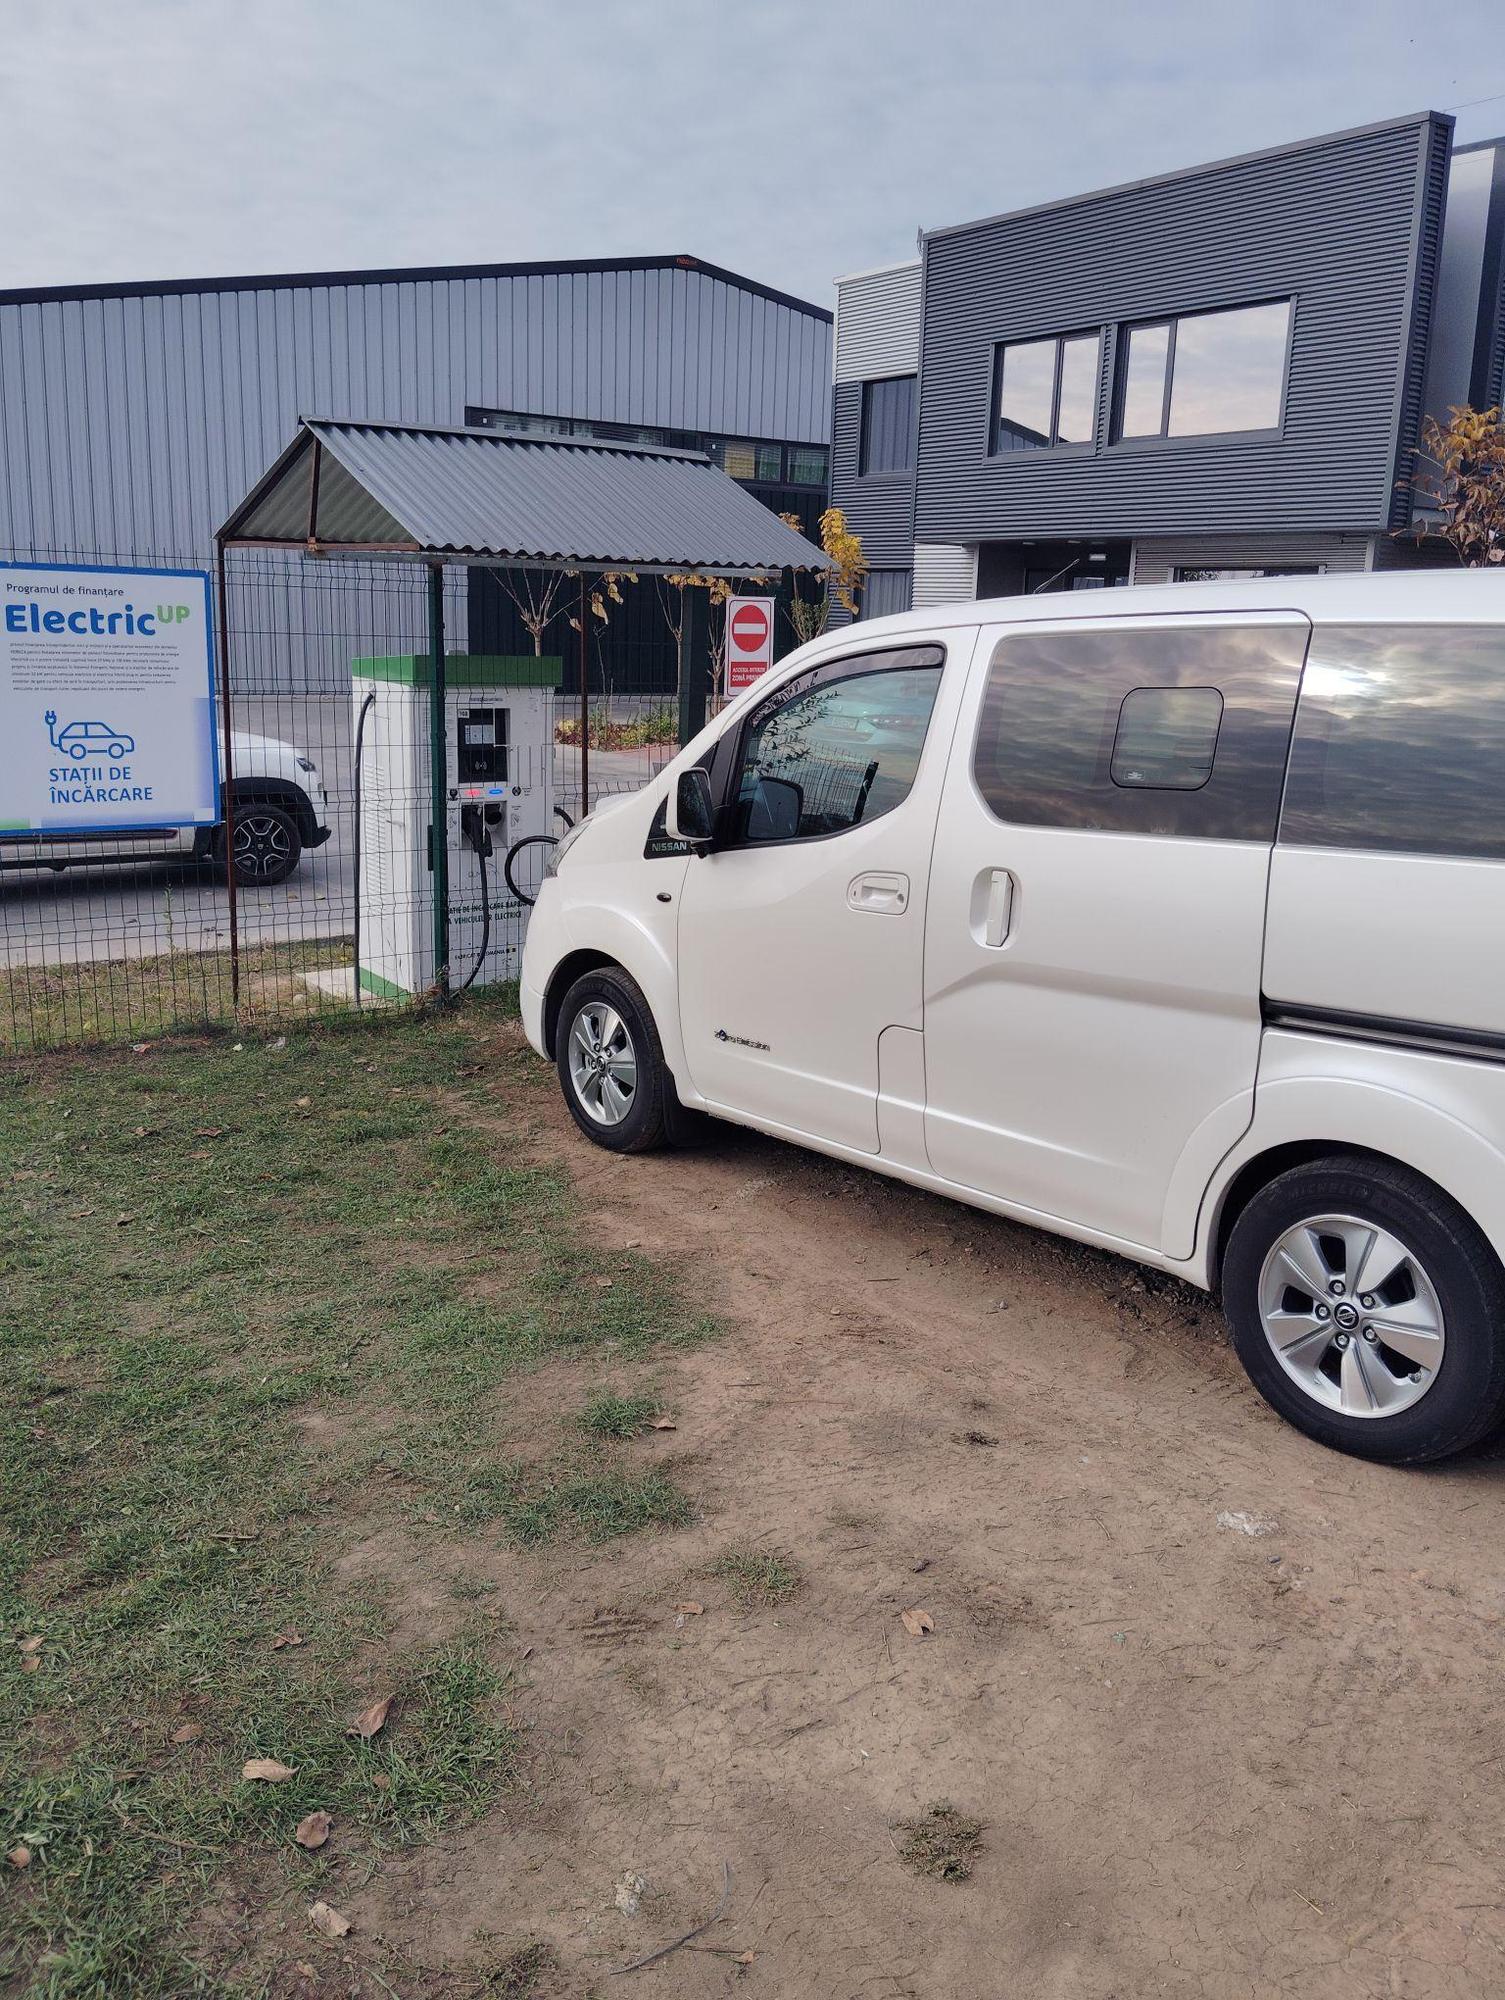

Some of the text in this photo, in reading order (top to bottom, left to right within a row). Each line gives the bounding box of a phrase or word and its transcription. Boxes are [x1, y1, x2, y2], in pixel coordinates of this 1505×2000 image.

[6, 583, 59, 595] Programul
[62, 585, 75, 594] de
[109, 766, 131, 780] DE
[49, 785, 153, 803] ÎNCĂRCARE
[651, 841, 687, 852] NISSAN
